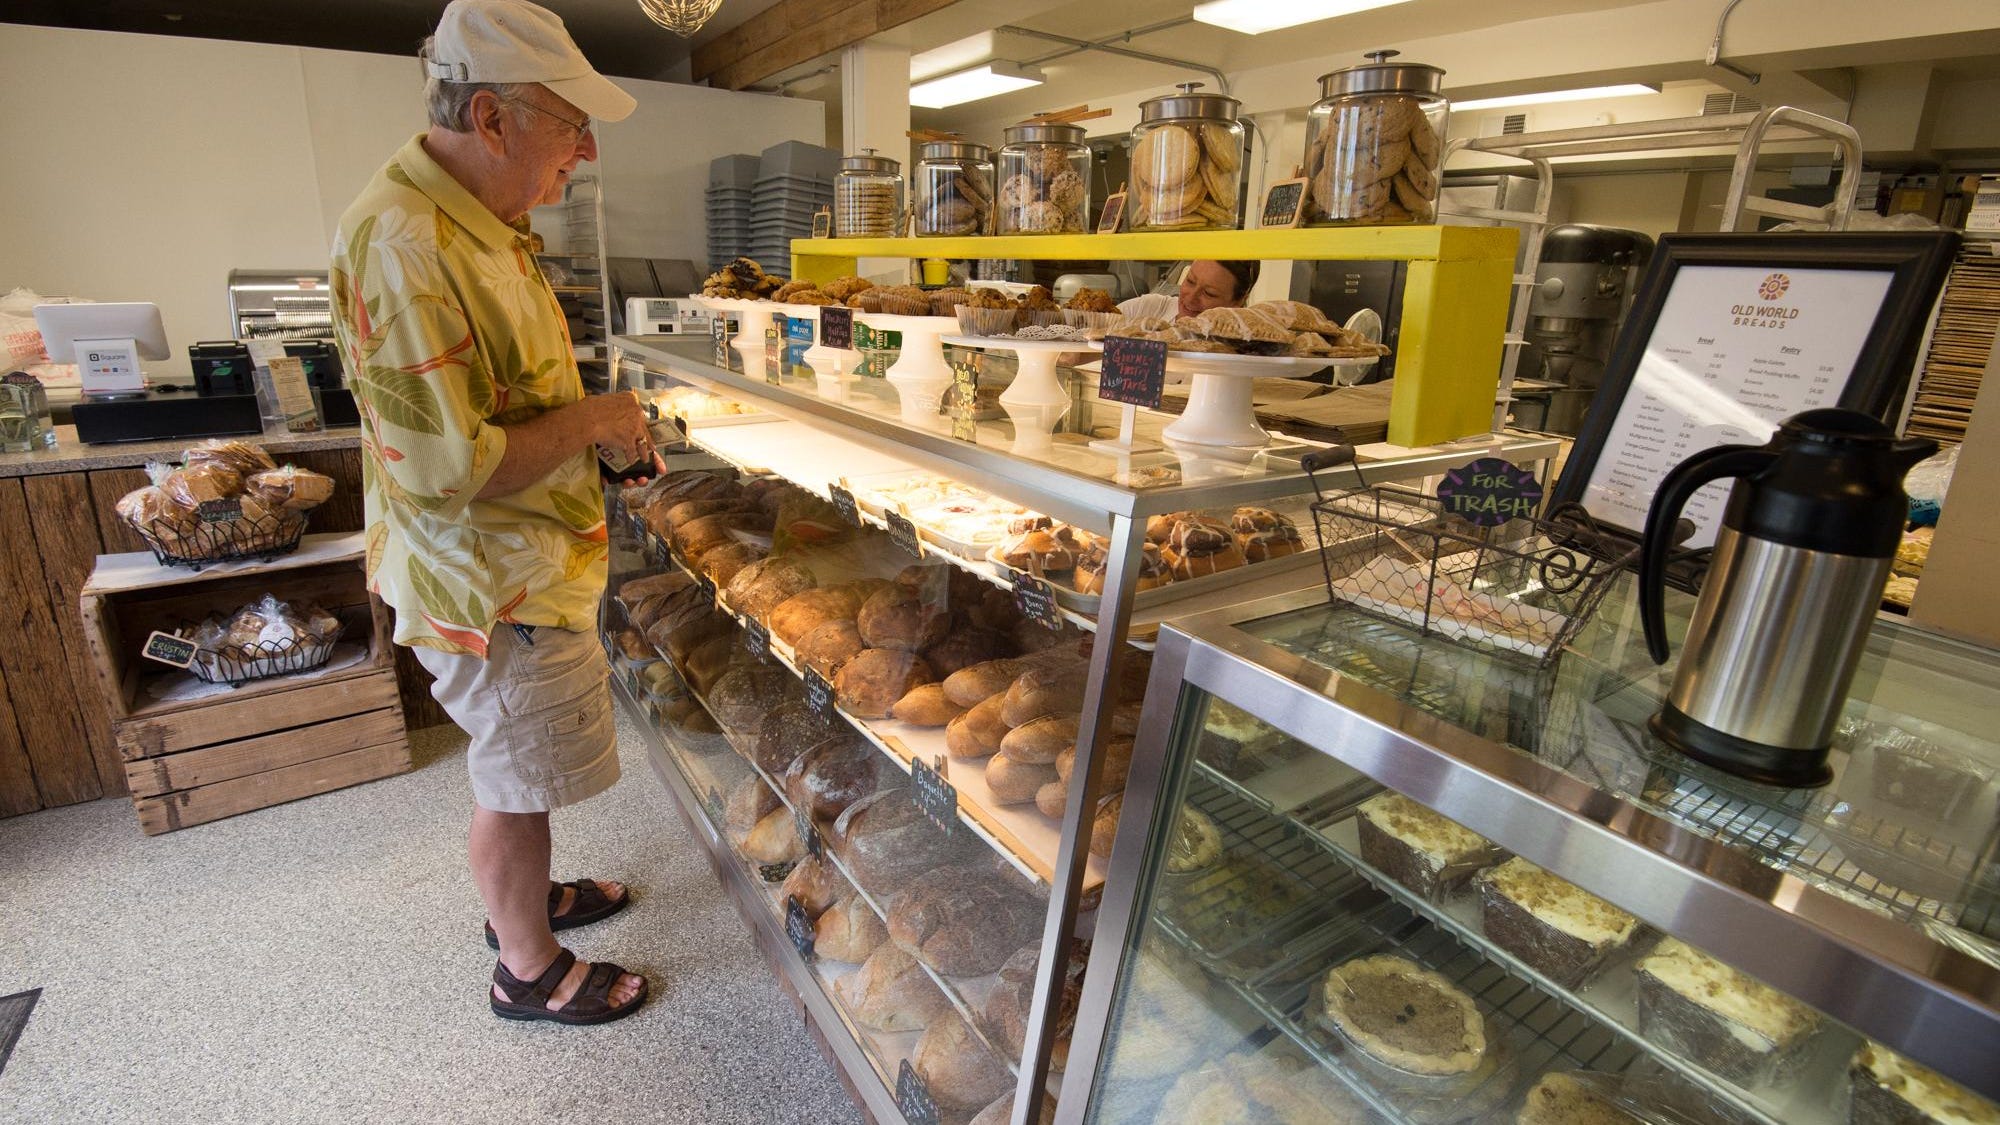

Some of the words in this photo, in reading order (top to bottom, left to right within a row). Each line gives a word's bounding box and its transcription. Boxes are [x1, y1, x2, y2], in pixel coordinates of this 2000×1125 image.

[1730, 304, 1754, 317] OLD
[1755, 306, 1799, 320] WORLD
[1733, 317, 1787, 330] BREADS
[1780, 344, 1802, 355] Pastry
[1471, 473, 1514, 488] FOR
[1449, 493, 1532, 518] TRASH
[918, 770, 948, 805] Baguette
